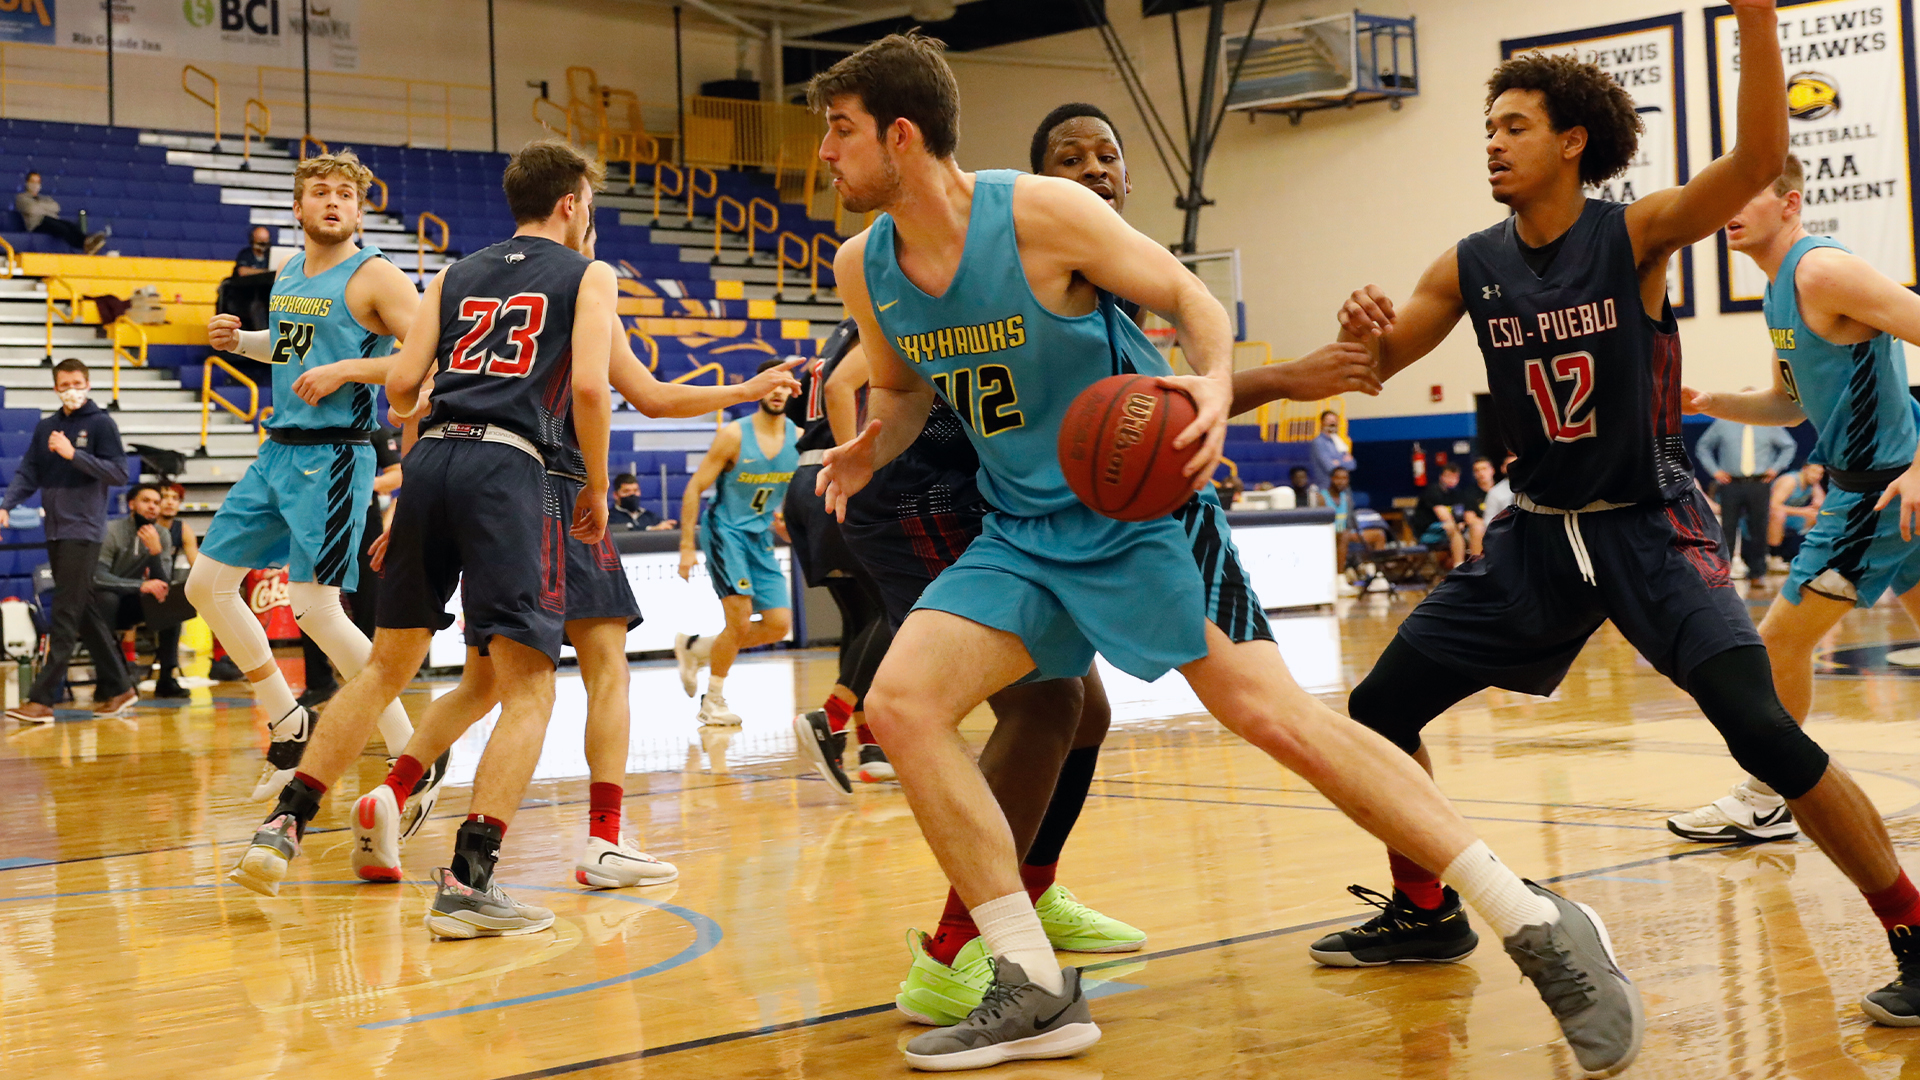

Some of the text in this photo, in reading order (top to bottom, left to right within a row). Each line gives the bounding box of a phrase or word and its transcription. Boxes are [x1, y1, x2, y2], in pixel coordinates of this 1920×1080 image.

[220, 0, 280, 35] BCI
[1801, 7, 1884, 37] LEWIS
[96, 34, 138, 50] Gnde
[1790, 124, 1877, 147] KETBALL
[1803, 179, 1897, 206] NAMENT
[269, 294, 333, 317] SKYHAWKS
[445, 292, 549, 378] 23
[1488, 316, 1524, 348] CSU
[1537, 298, 1618, 343] PUEBLO
[271, 320, 315, 365] 24
[1524, 350, 1597, 443] 12
[1104, 392, 1159, 486] Wilson
[751, 487, 774, 515] 4
